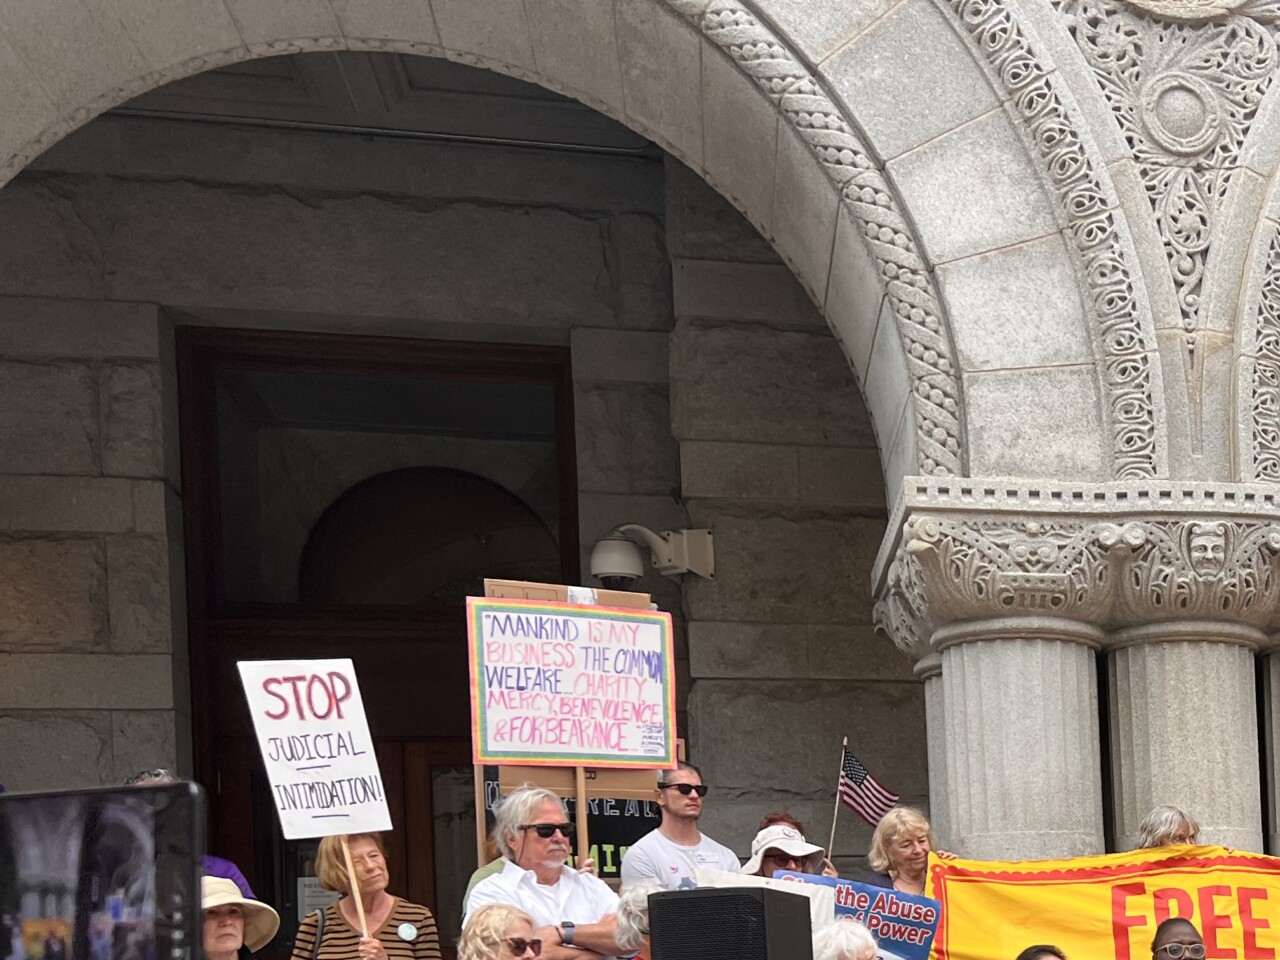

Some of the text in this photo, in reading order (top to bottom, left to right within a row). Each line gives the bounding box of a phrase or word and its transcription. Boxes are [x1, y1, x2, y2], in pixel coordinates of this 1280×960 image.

[588, 620, 603, 643] IS
[608, 622, 640, 647] MY
[486, 641, 576, 668] BUSINESS
[580, 645, 610, 674] THE
[262, 671, 353, 721] STOP
[268, 730, 366, 762] JUDICIAL
[274, 774, 384, 811] INTIMIDATION!
[836, 884, 937, 925] the Abuse
[867, 914, 931, 946] Power
